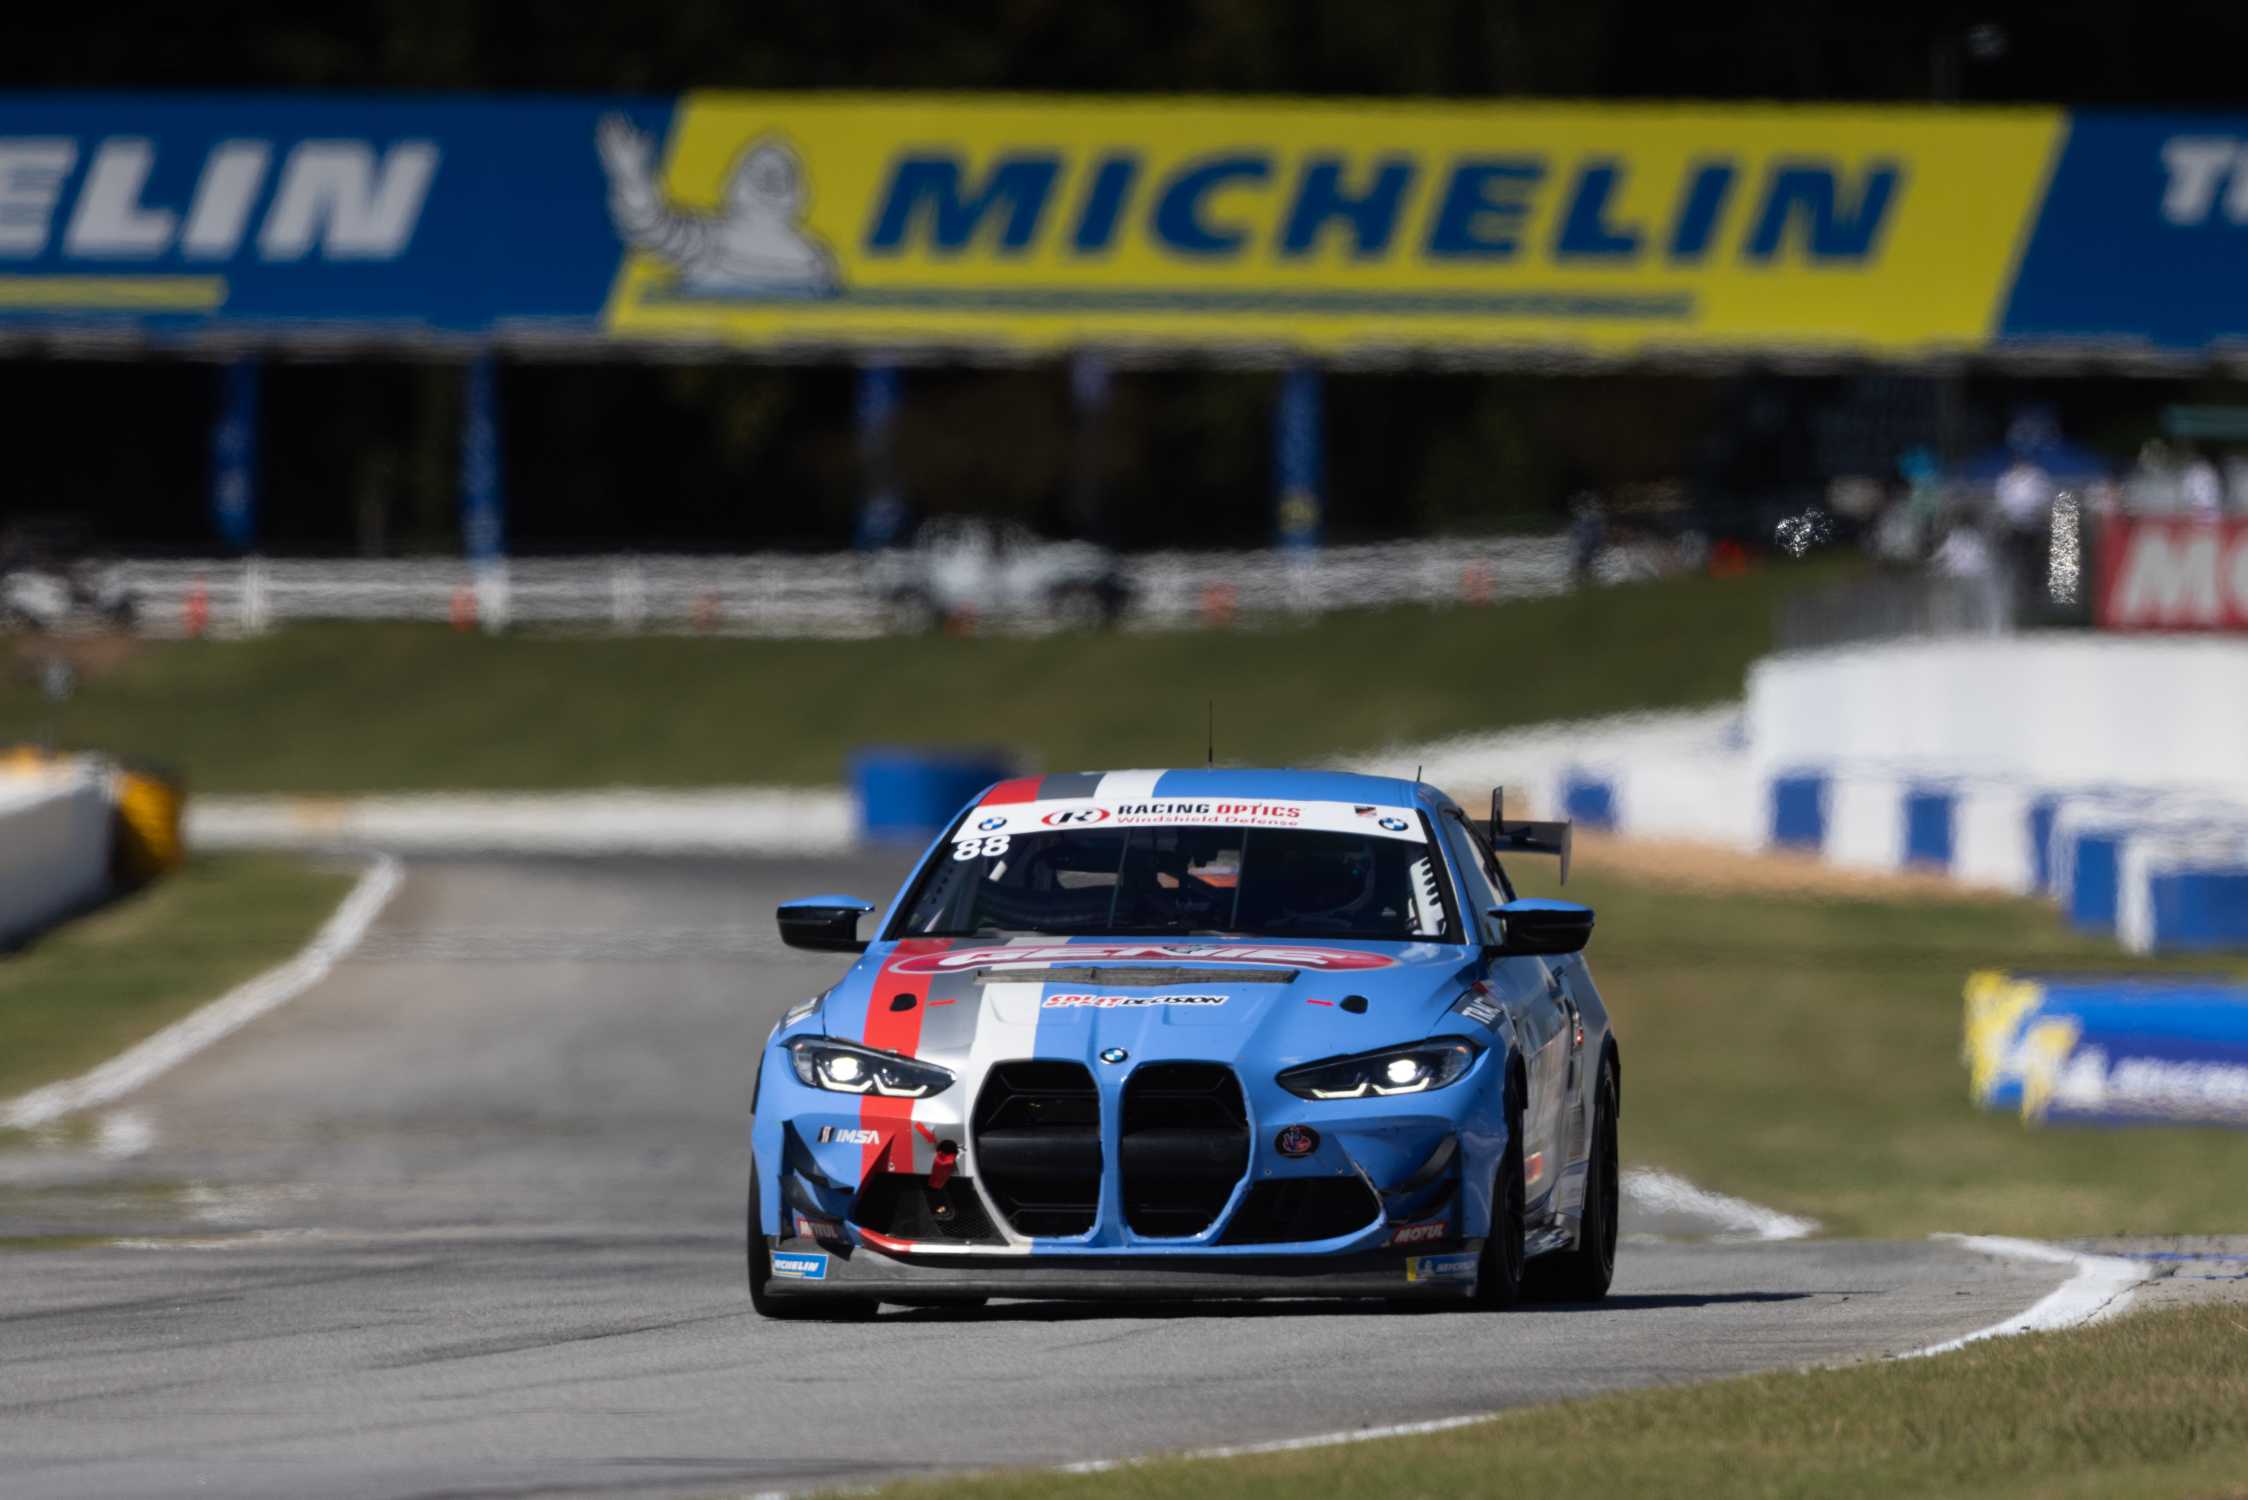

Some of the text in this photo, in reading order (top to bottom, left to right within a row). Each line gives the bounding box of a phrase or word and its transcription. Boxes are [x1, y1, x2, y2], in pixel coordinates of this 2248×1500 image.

[864, 149, 1905, 265] MICHELIN
[1117, 803, 1301, 818] RACING OPTICS
[1117, 815, 1300, 826] Windshield Defense
[953, 834, 1010, 861] 88
[836, 1129, 880, 1145] IMSA
